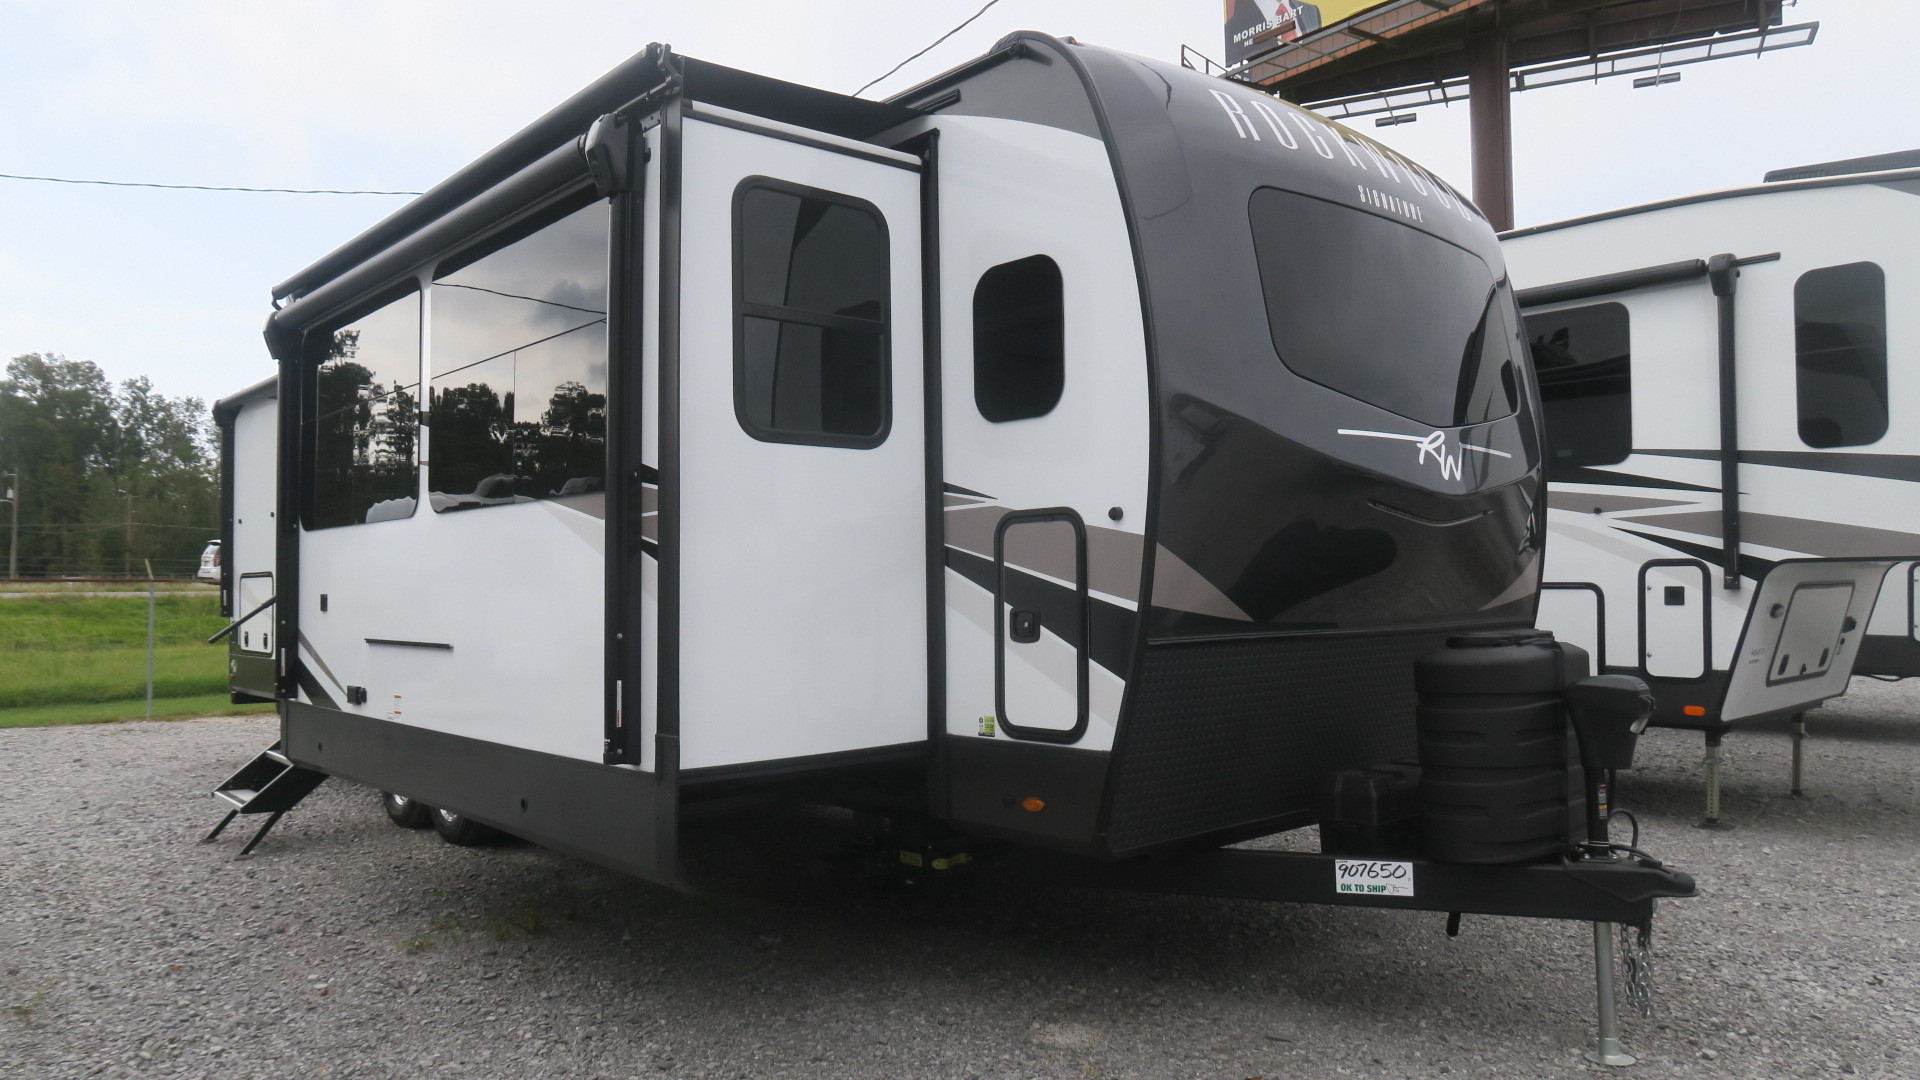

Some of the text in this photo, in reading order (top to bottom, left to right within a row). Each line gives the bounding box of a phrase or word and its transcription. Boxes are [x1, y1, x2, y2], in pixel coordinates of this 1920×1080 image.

[1233, 5, 1304, 44] MORRIS BART
[1208, 88, 1472, 222] ROCKWOOD
[1357, 184, 1424, 223] SIGNATURE
[1416, 430, 1463, 481] RW
[1338, 862, 1407, 879] 907650
[1340, 883, 1353, 892] OK
[1353, 883, 1365, 892] TO
[1366, 884, 1387, 893] SHIP
